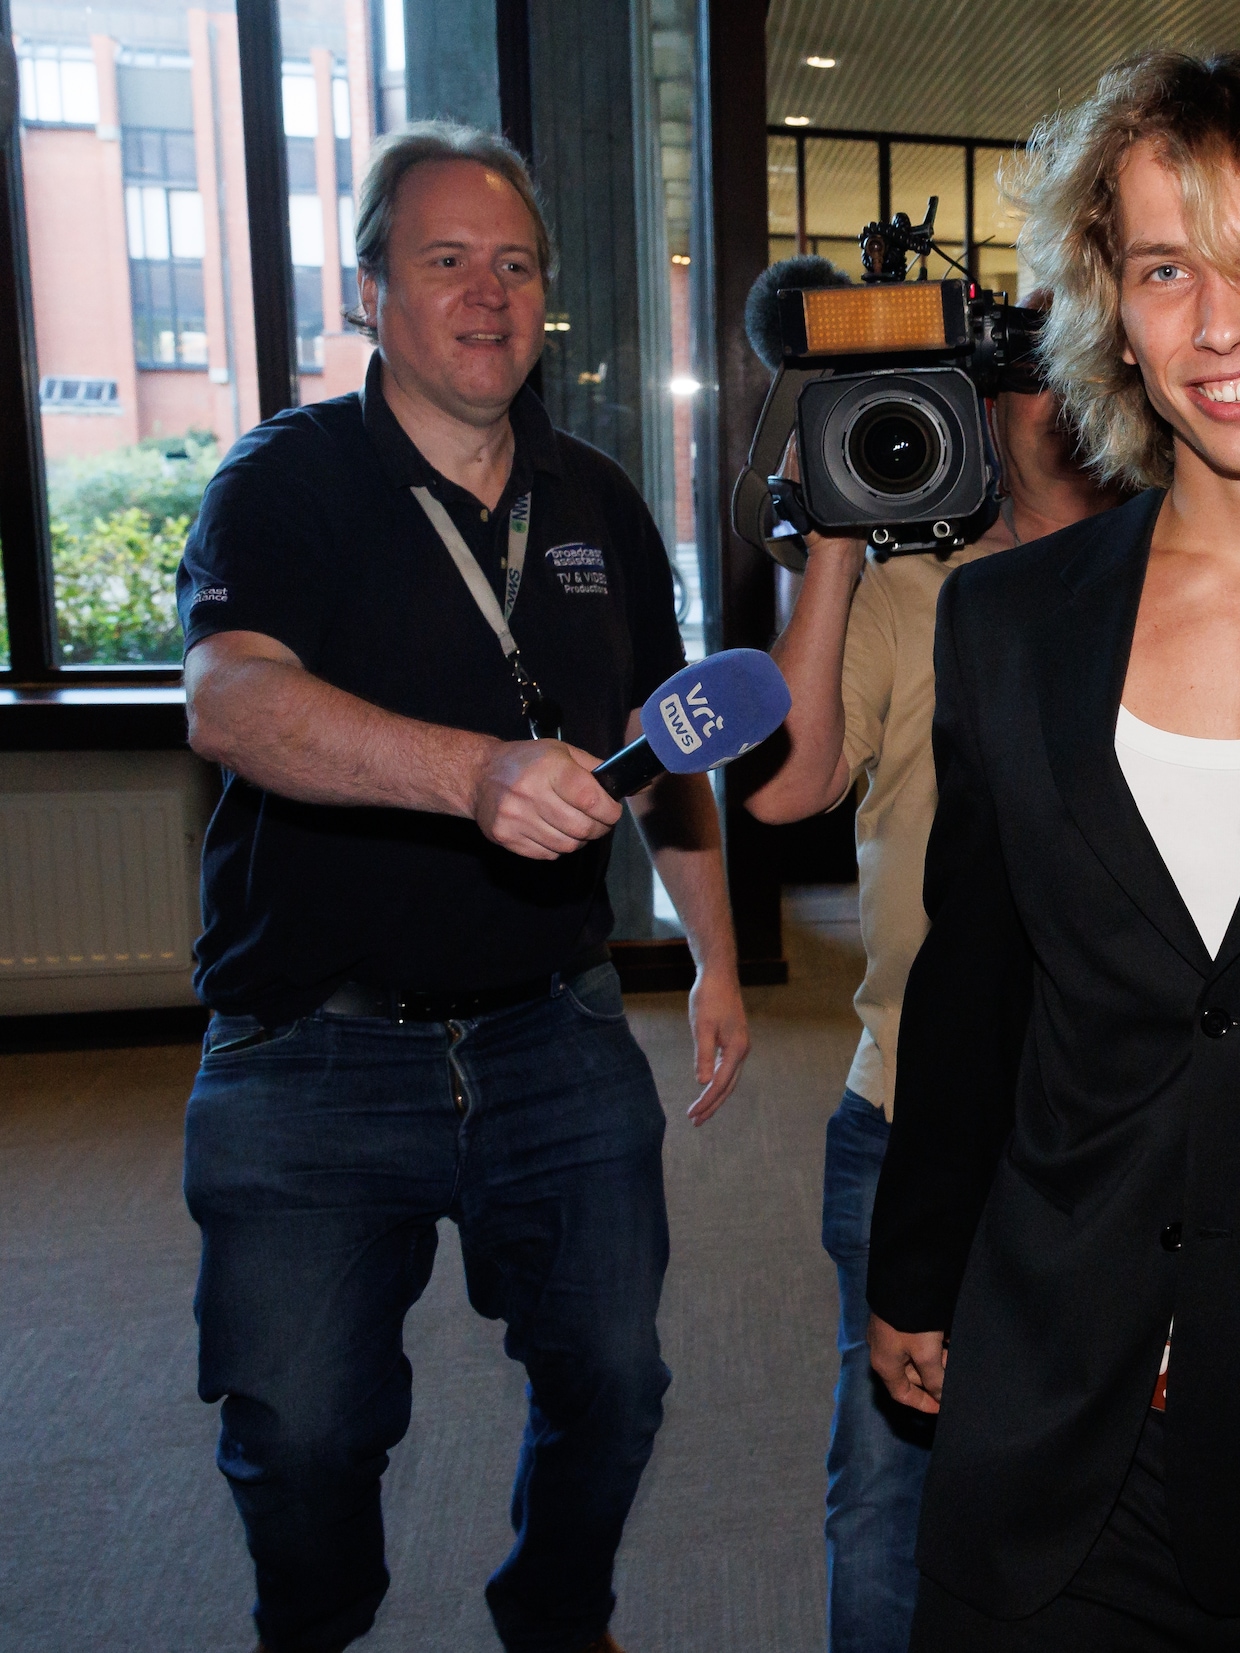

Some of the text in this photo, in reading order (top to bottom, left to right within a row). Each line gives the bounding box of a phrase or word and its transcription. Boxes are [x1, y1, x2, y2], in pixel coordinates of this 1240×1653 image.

[557, 572, 571, 584] TV
[574, 572, 582, 583] &
[665, 701, 694, 747] nws
[685, 682, 724, 739] vrt
